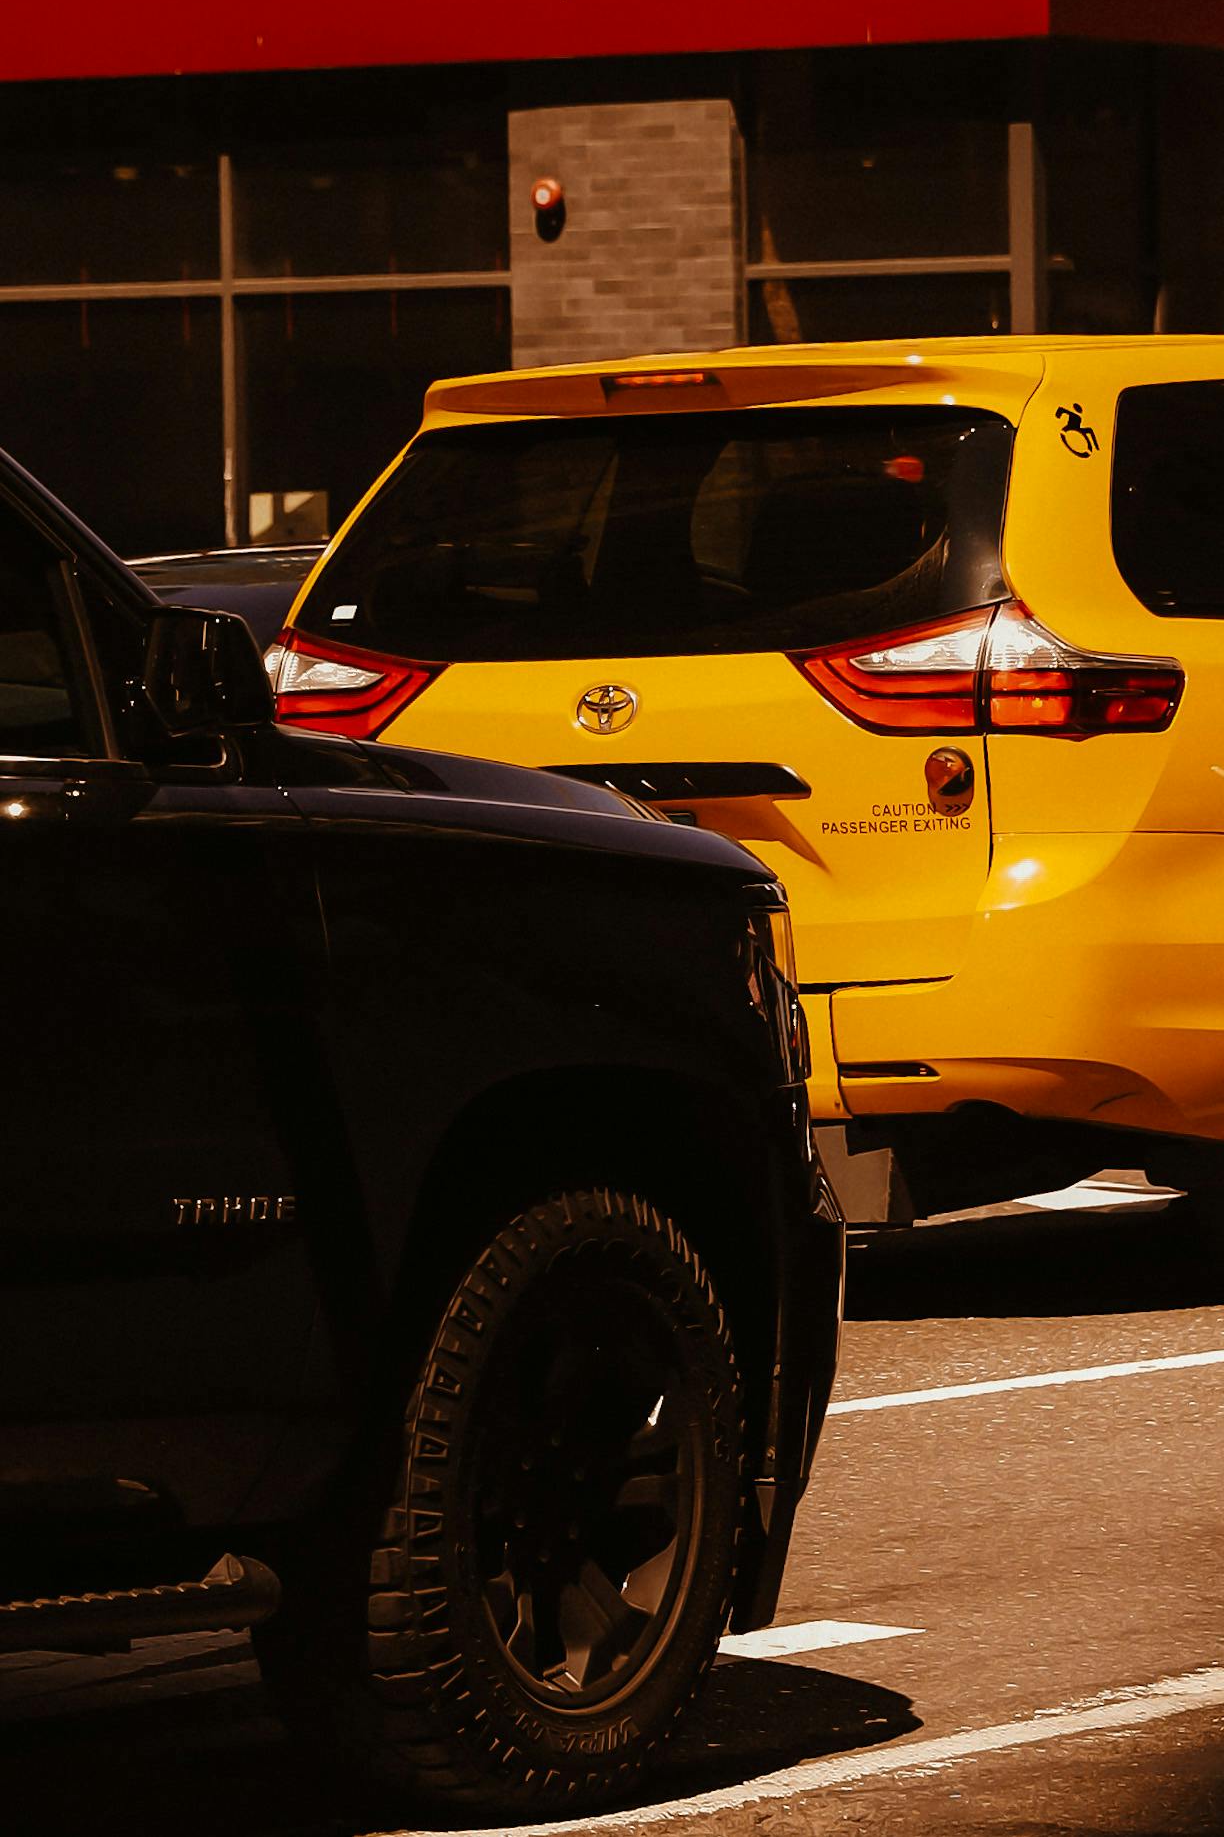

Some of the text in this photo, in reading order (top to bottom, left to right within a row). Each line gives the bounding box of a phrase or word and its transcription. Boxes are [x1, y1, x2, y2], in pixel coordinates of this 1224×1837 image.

[871, 802, 937, 817] CAUTION
[821, 817, 971, 834] PASSENGER EXITING
